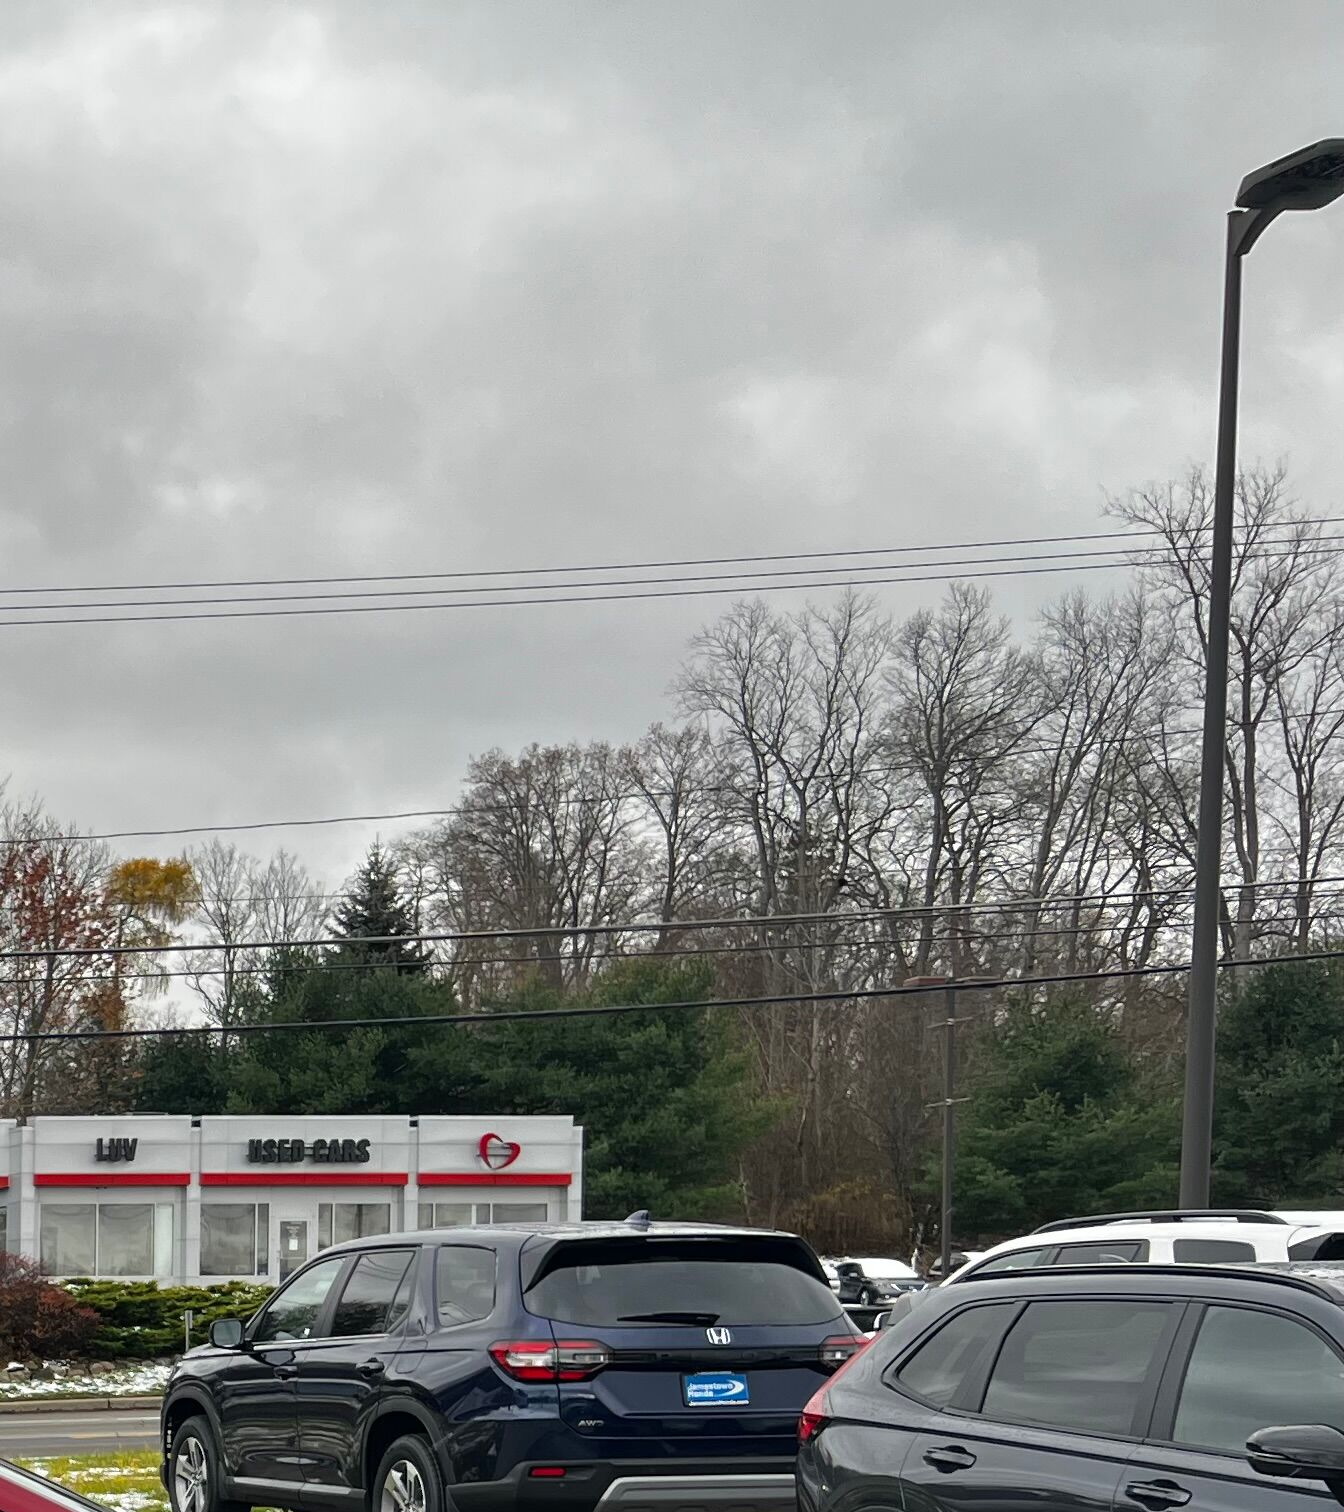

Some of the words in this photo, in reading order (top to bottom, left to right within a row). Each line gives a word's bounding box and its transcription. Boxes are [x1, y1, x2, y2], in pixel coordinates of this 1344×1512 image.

[96, 1138, 138, 1162] LUV
[248, 1139, 305, 1163] USED
[312, 1139, 370, 1163] CARS
